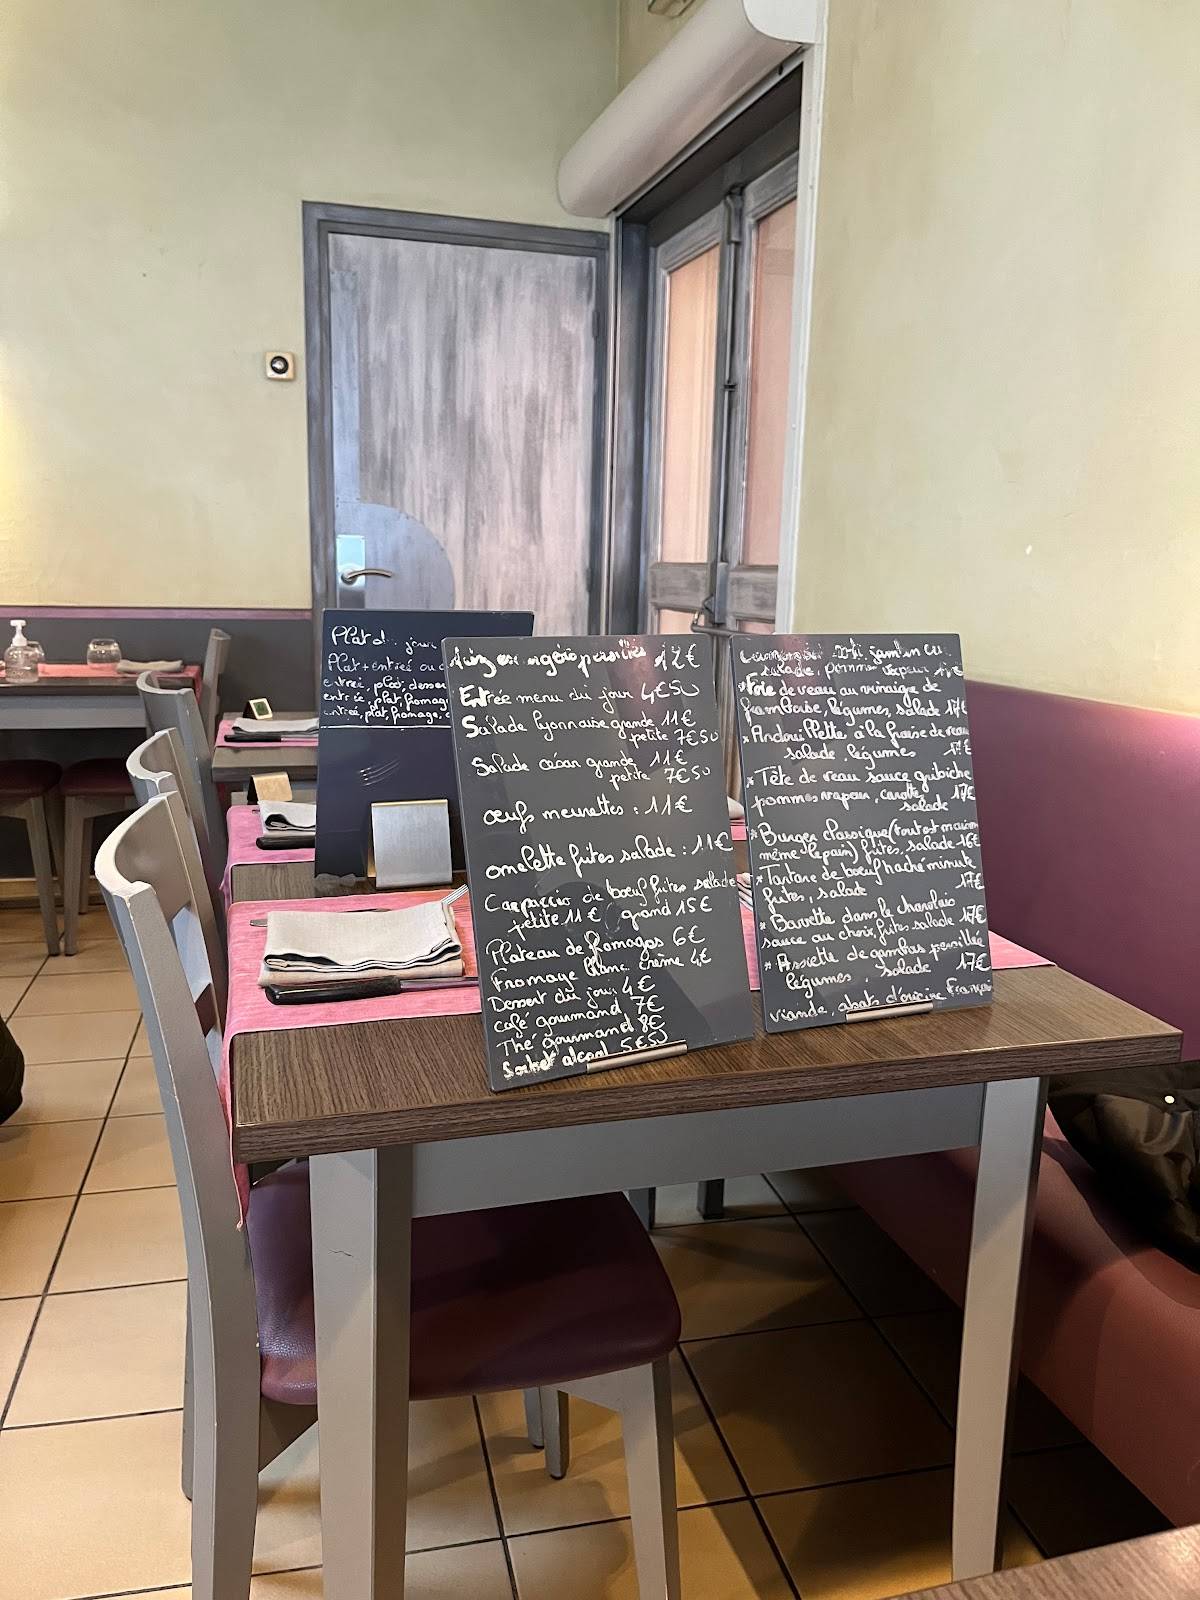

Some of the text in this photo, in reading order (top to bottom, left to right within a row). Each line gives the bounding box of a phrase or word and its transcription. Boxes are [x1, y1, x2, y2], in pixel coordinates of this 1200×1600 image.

[328, 652, 360, 672] Plat
[419, 664, 437, 672] ou
[408, 678, 447, 690] desser
[516, 693, 563, 704] menu
[568, 684, 593, 701] du
[598, 687, 634, 714] jour
[779, 680, 796, 696] de
[797, 685, 837, 696] veau
[839, 686, 859, 697] au
[922, 676, 942, 692] de
[364, 704, 389, 723] plat,
[390, 705, 442, 724] fromage,
[404, 692, 449, 711] fromag
[826, 697, 892, 727] légumes,
[895, 697, 942, 717] salade
[461, 709, 697, 741] Salade lyonnaise grande 11€
[629, 727, 669, 749] petite
[751, 717, 848, 743] Andouillette
[853, 725, 865, 740] à
[864, 719, 887, 739] la
[928, 722, 947, 738] de
[471, 752, 530, 777] Salade
[585, 750, 637, 779] grande
[649, 749, 688, 768] 11€
[846, 743, 917, 771] légumes
[609, 767, 651, 791] petite
[753, 765, 795, 787] Tête
[798, 767, 818, 784] de
[822, 770, 862, 782] veau
[864, 771, 912, 784] sauce
[644, 793, 693, 816] 11€
[898, 794, 950, 812] salade
[950, 782, 977, 803] 17€
[757, 822, 819, 854] Burger
[822, 818, 889, 849] classique
[758, 847, 801, 861] même
[807, 841, 823, 859] le
[904, 834, 956, 852] salade
[955, 832, 981, 849] 16€
[485, 843, 567, 879] omelette
[568, 842, 615, 879] frites
[620, 834, 676, 863] salade
[691, 831, 733, 855] 11€
[758, 862, 818, 886] Tartare
[821, 865, 845, 881] de
[881, 854, 926, 875] haché
[926, 849, 977, 871] minute
[582, 884, 604, 903] de
[649, 874, 687, 904] frites
[693, 870, 737, 891] salade
[816, 880, 868, 901] salade
[955, 871, 985, 890] 17€
[507, 908, 560, 941] petite
[621, 898, 671, 931] grand
[676, 896, 712, 916] 15€
[769, 888, 986, 933] Bavette dans le charolais 17€
[761, 937, 808, 949] sauce
[811, 932, 835, 944] au
[875, 917, 910, 947] frites
[911, 909, 955, 931] salade
[485, 938, 560, 966] Plateau
[565, 937, 584, 956] de
[672, 925, 706, 946] 6€
[776, 946, 840, 972] Assiette
[846, 944, 870, 961] de
[869, 936, 927, 970] gambas
[490, 967, 579, 993] Fromage
[690, 947, 712, 968] 4€
[880, 956, 932, 978] salade
[955, 951, 992, 972] 17€
[486, 990, 547, 1013] Dessert
[554, 987, 582, 1004] du
[622, 974, 656, 996] 4€
[493, 994, 665, 1039] café gourmand 7€
[496, 1012, 666, 1057] Thé gourmand 8€
[561, 1039, 609, 1068] alcool
